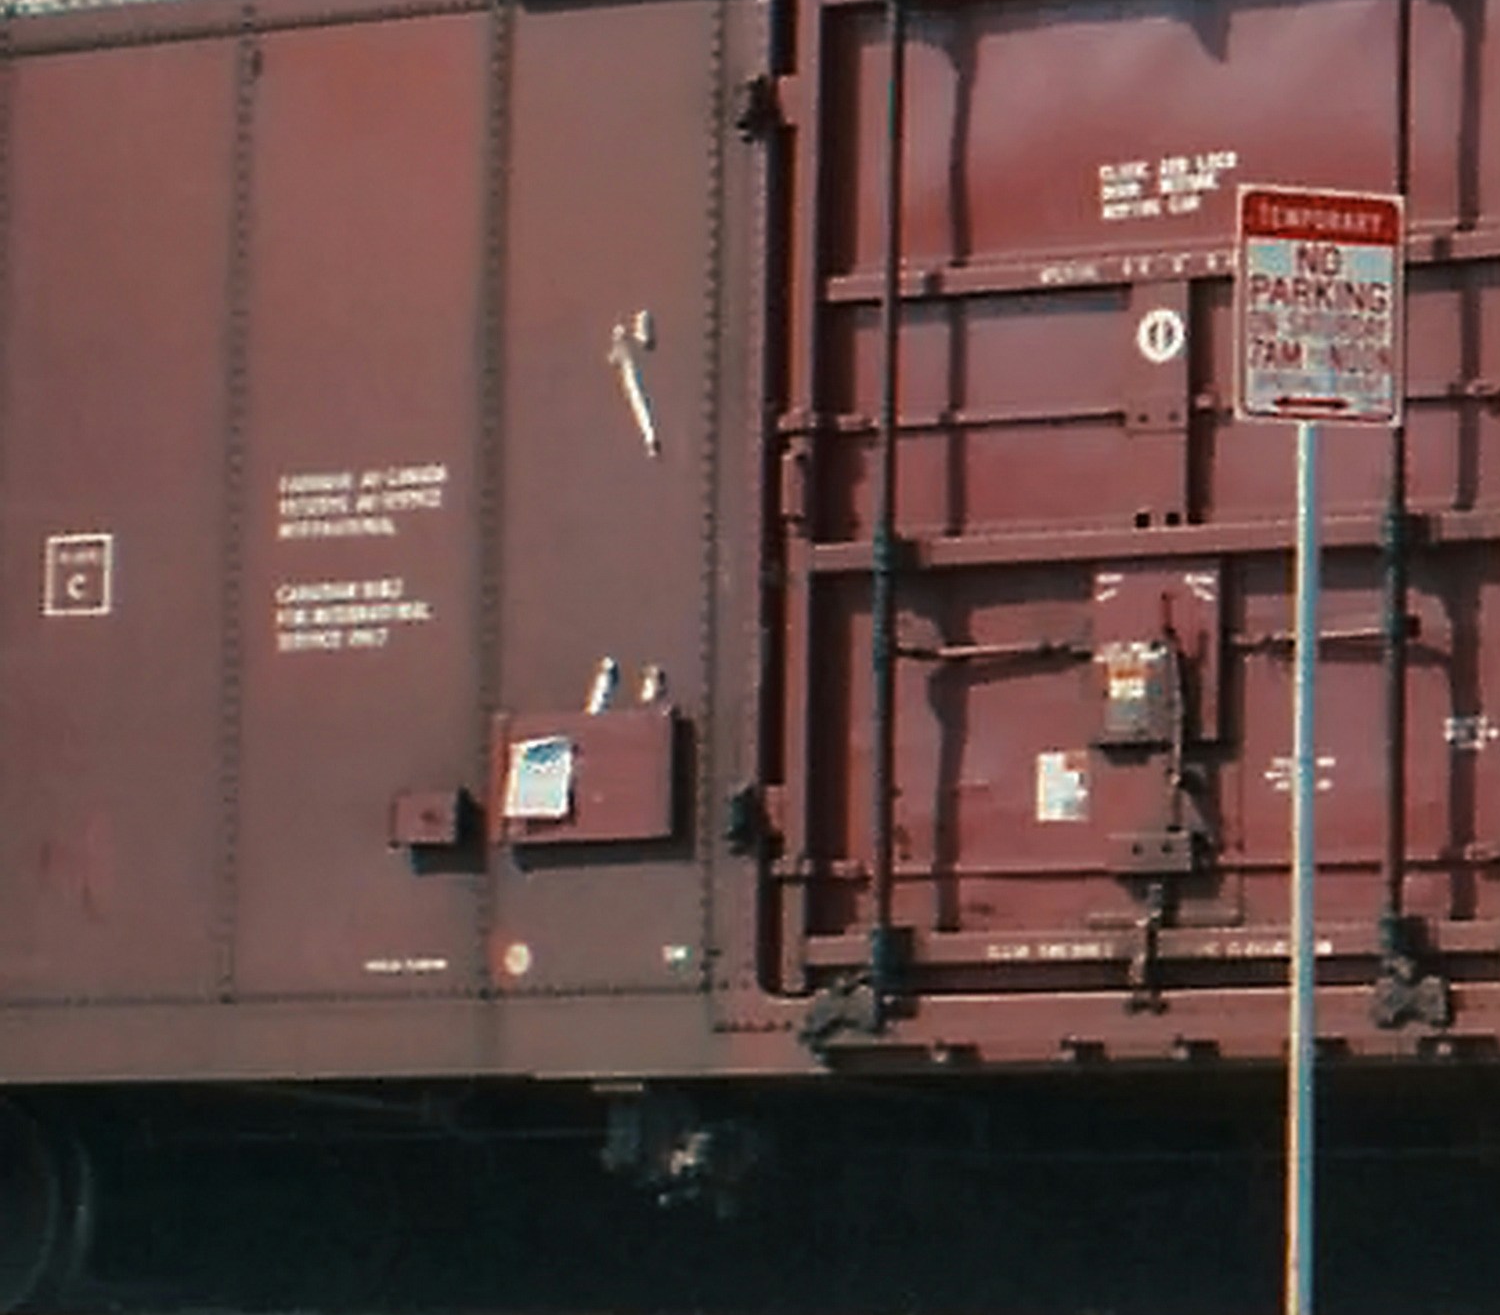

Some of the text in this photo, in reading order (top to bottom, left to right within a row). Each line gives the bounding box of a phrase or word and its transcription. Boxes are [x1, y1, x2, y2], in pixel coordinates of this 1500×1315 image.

[1259, 201, 1383, 231] TEMPORARY
[1296, 243, 1341, 276] NO
[1250, 273, 1388, 314] PARKING
